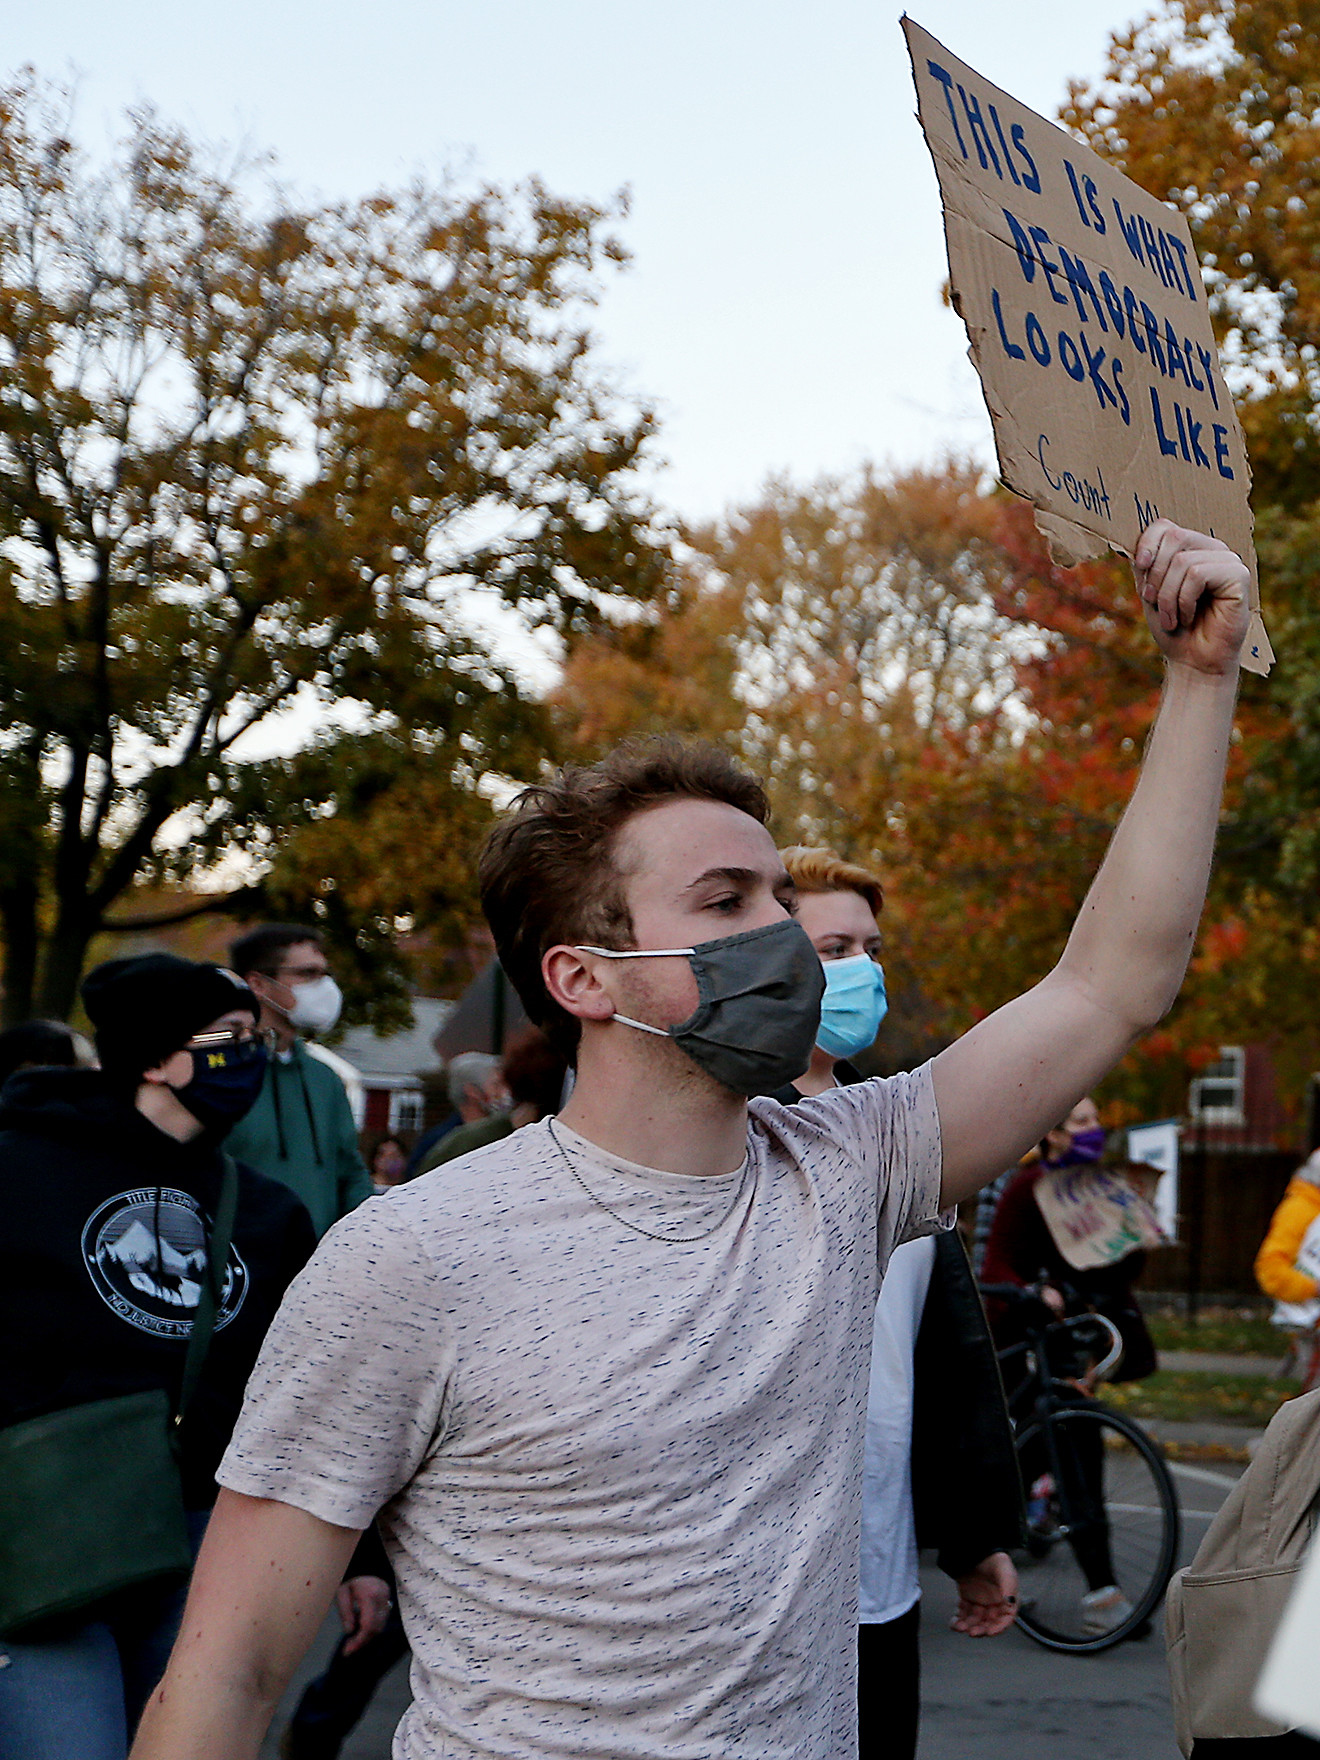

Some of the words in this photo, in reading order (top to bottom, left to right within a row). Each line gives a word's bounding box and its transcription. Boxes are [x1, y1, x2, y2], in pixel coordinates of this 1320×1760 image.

[927, 59, 1041, 194] THIS
[1063, 159, 1106, 235] IS
[1112, 198, 1197, 301] WHAT
[992, 287, 1131, 426] LOOKS
[1149, 387, 1235, 480] LIKE
[1002, 207, 1219, 411] DEMOCRACY
[1038, 434, 1112, 521] Count
